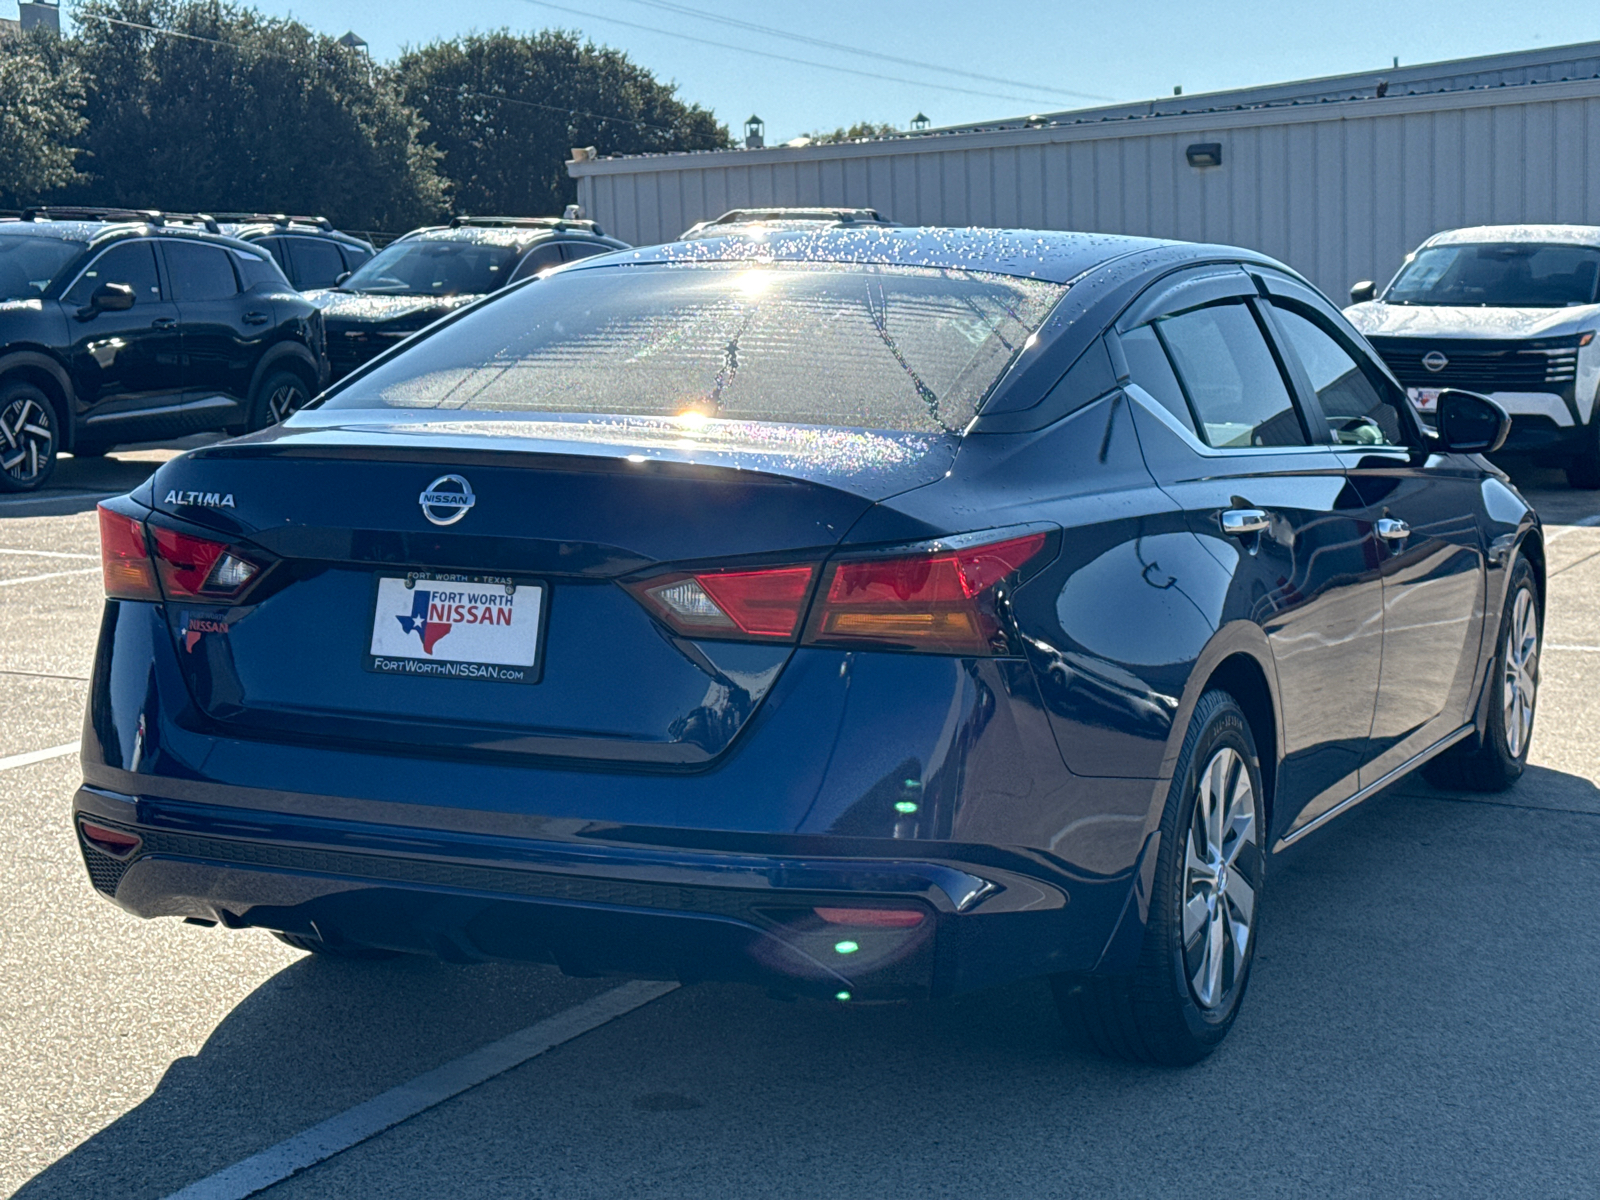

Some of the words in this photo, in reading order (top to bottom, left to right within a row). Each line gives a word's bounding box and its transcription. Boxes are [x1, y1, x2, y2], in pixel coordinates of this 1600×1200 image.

[164, 489, 235, 508] ALTIMA
[423, 494, 468, 505] NISSAN
[407, 571, 431, 580] FORT
[435, 573, 468, 582] WORTH
[483, 575, 513, 585] TEXAS
[431, 591, 465, 604] FORT
[467, 593, 514, 606] WORTH
[429, 603, 513, 626] NISSAN
[189, 619, 229, 634] NISSAN
